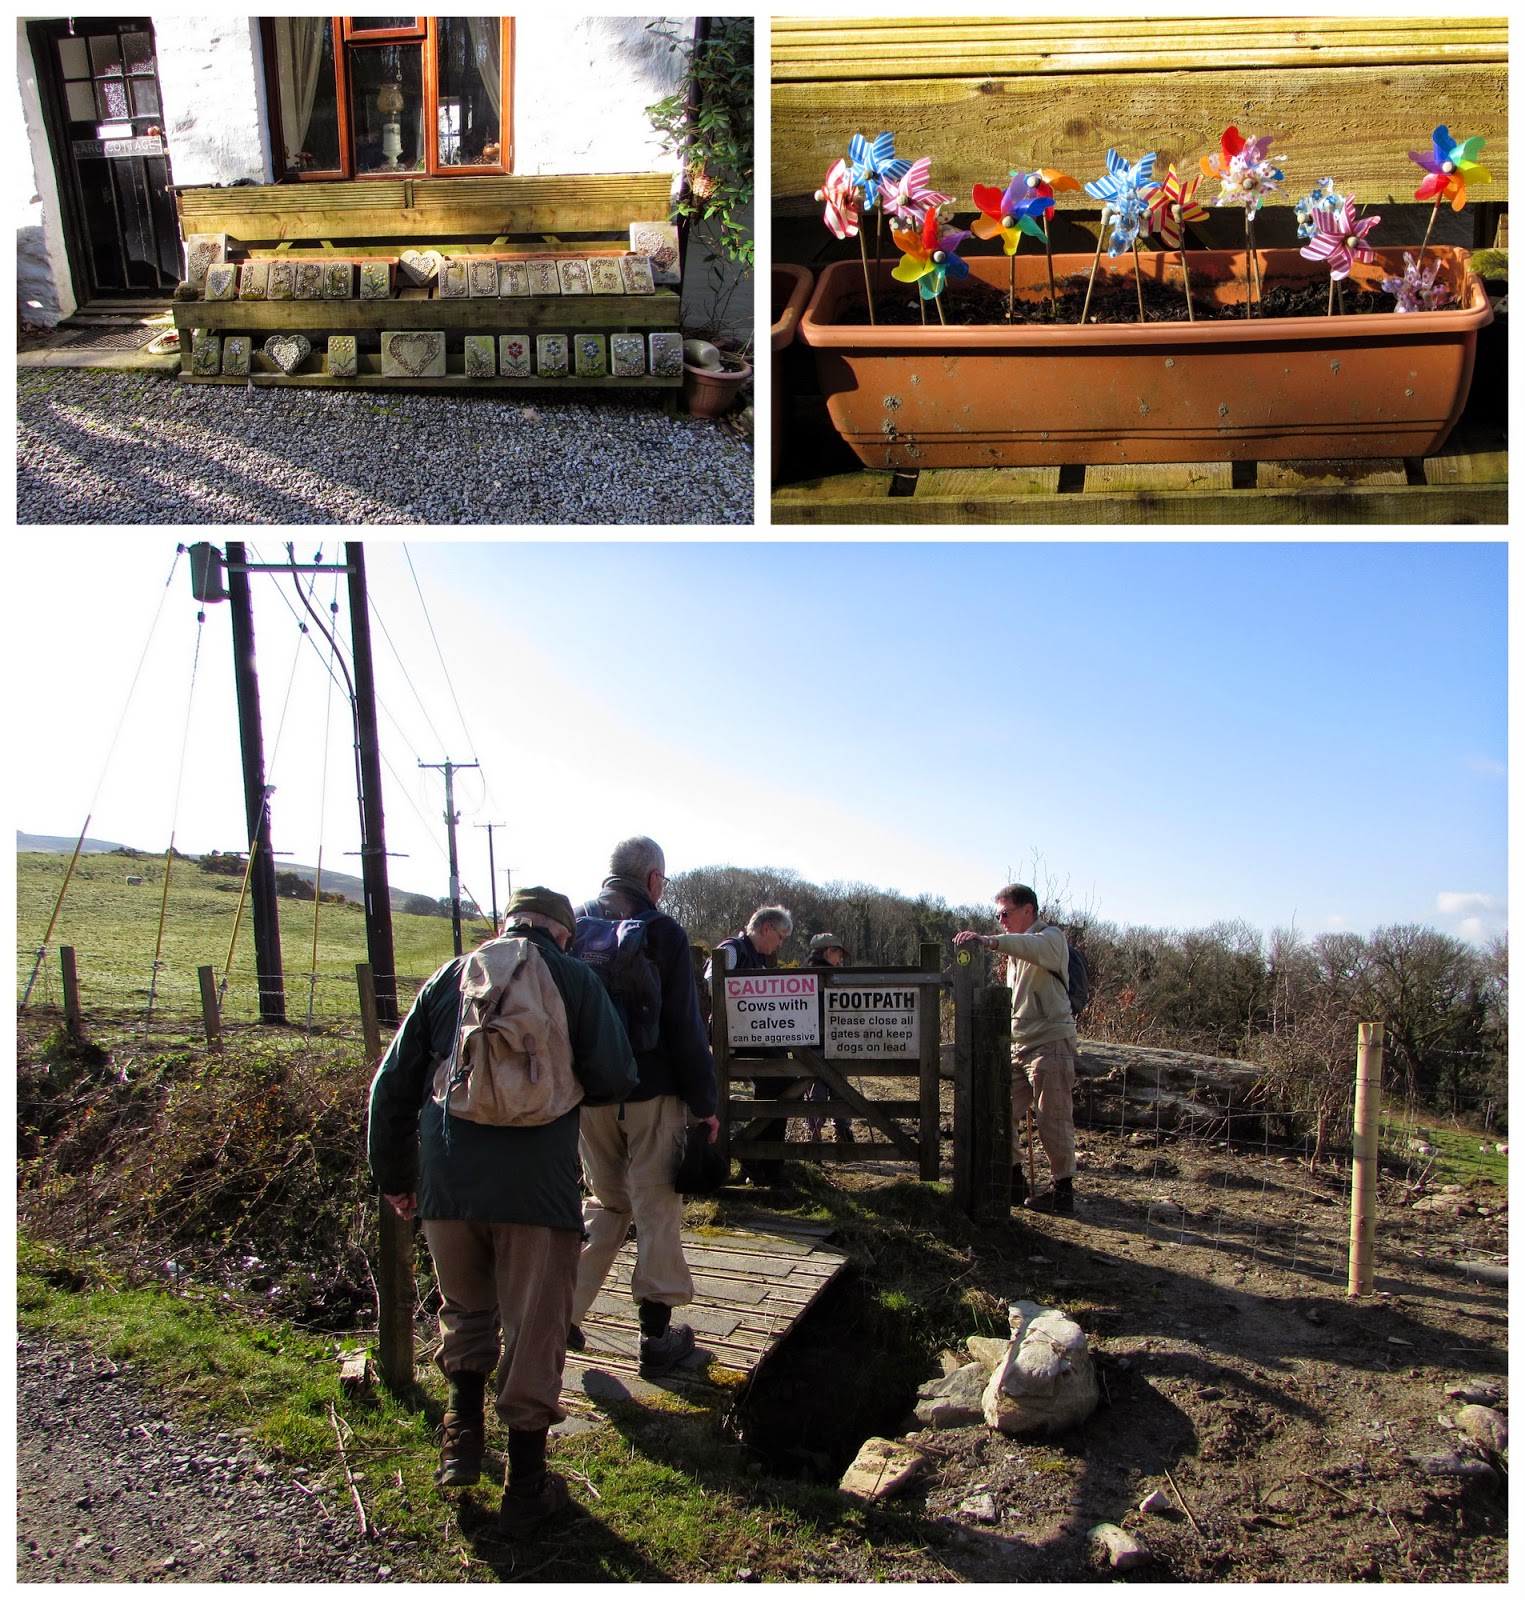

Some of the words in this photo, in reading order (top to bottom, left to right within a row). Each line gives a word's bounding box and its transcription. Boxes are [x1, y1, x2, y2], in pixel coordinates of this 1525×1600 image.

[75, 143, 102, 154] LARG
[106, 140, 156, 152] COTTAGE
[240, 263, 349, 296] LARG
[442, 256, 654, 296] COTTAGE
[728, 978, 815, 996] CAUTION
[737, 1000, 776, 1013] Cows
[779, 999, 808, 1011] with
[829, 992, 915, 1009] FOOTPATH
[751, 1017, 796, 1030] calves
[830, 1016, 866, 1025] Please
[868, 1015, 898, 1025] close
[901, 1015, 914, 1025] all
[751, 1034, 762, 1042] be
[764, 1033, 815, 1043] aggressive
[830, 1029, 860, 1041] gates
[863, 1029, 883, 1039] and
[886, 1029, 913, 1040] keep
[837, 1042, 864, 1053] dogs
[866, 1043, 880, 1051] on
[883, 1042, 906, 1051] lead
